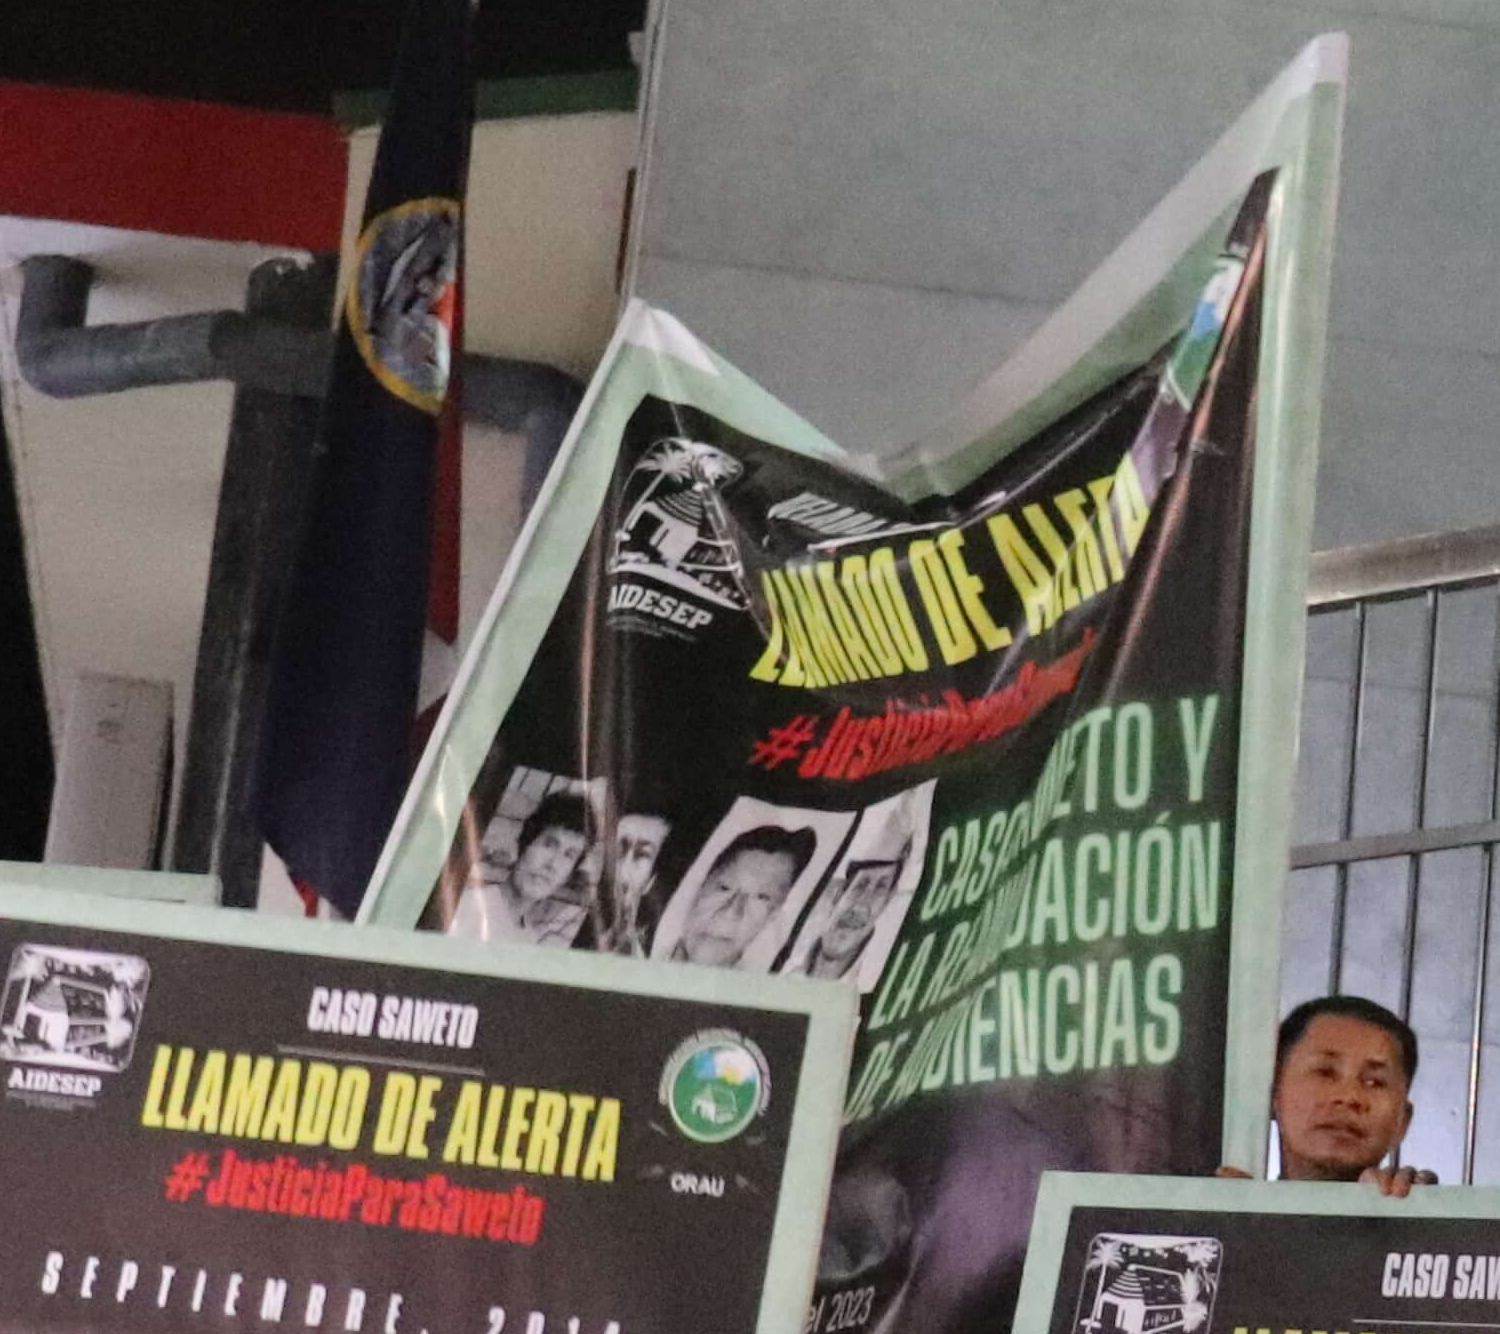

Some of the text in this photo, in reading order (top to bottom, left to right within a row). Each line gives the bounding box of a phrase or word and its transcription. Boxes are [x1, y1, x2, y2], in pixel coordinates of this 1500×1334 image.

[909, 529, 1013, 667] DE
[1179, 694, 1218, 802] Y
[306, 987, 480, 1049] CASO SAWETO
[869, 932, 936, 1031] LA
[8, 1067, 102, 1097] AIDESEP
[141, 1044, 622, 1183] LLAMADO DE ALERTA
[164, 1150, 548, 1246] #JusticiaParaSaweto
[670, 1172, 726, 1198] ORAU
[826, 1286, 876, 1334] 2023
[1381, 1252, 1450, 1298] CASO
